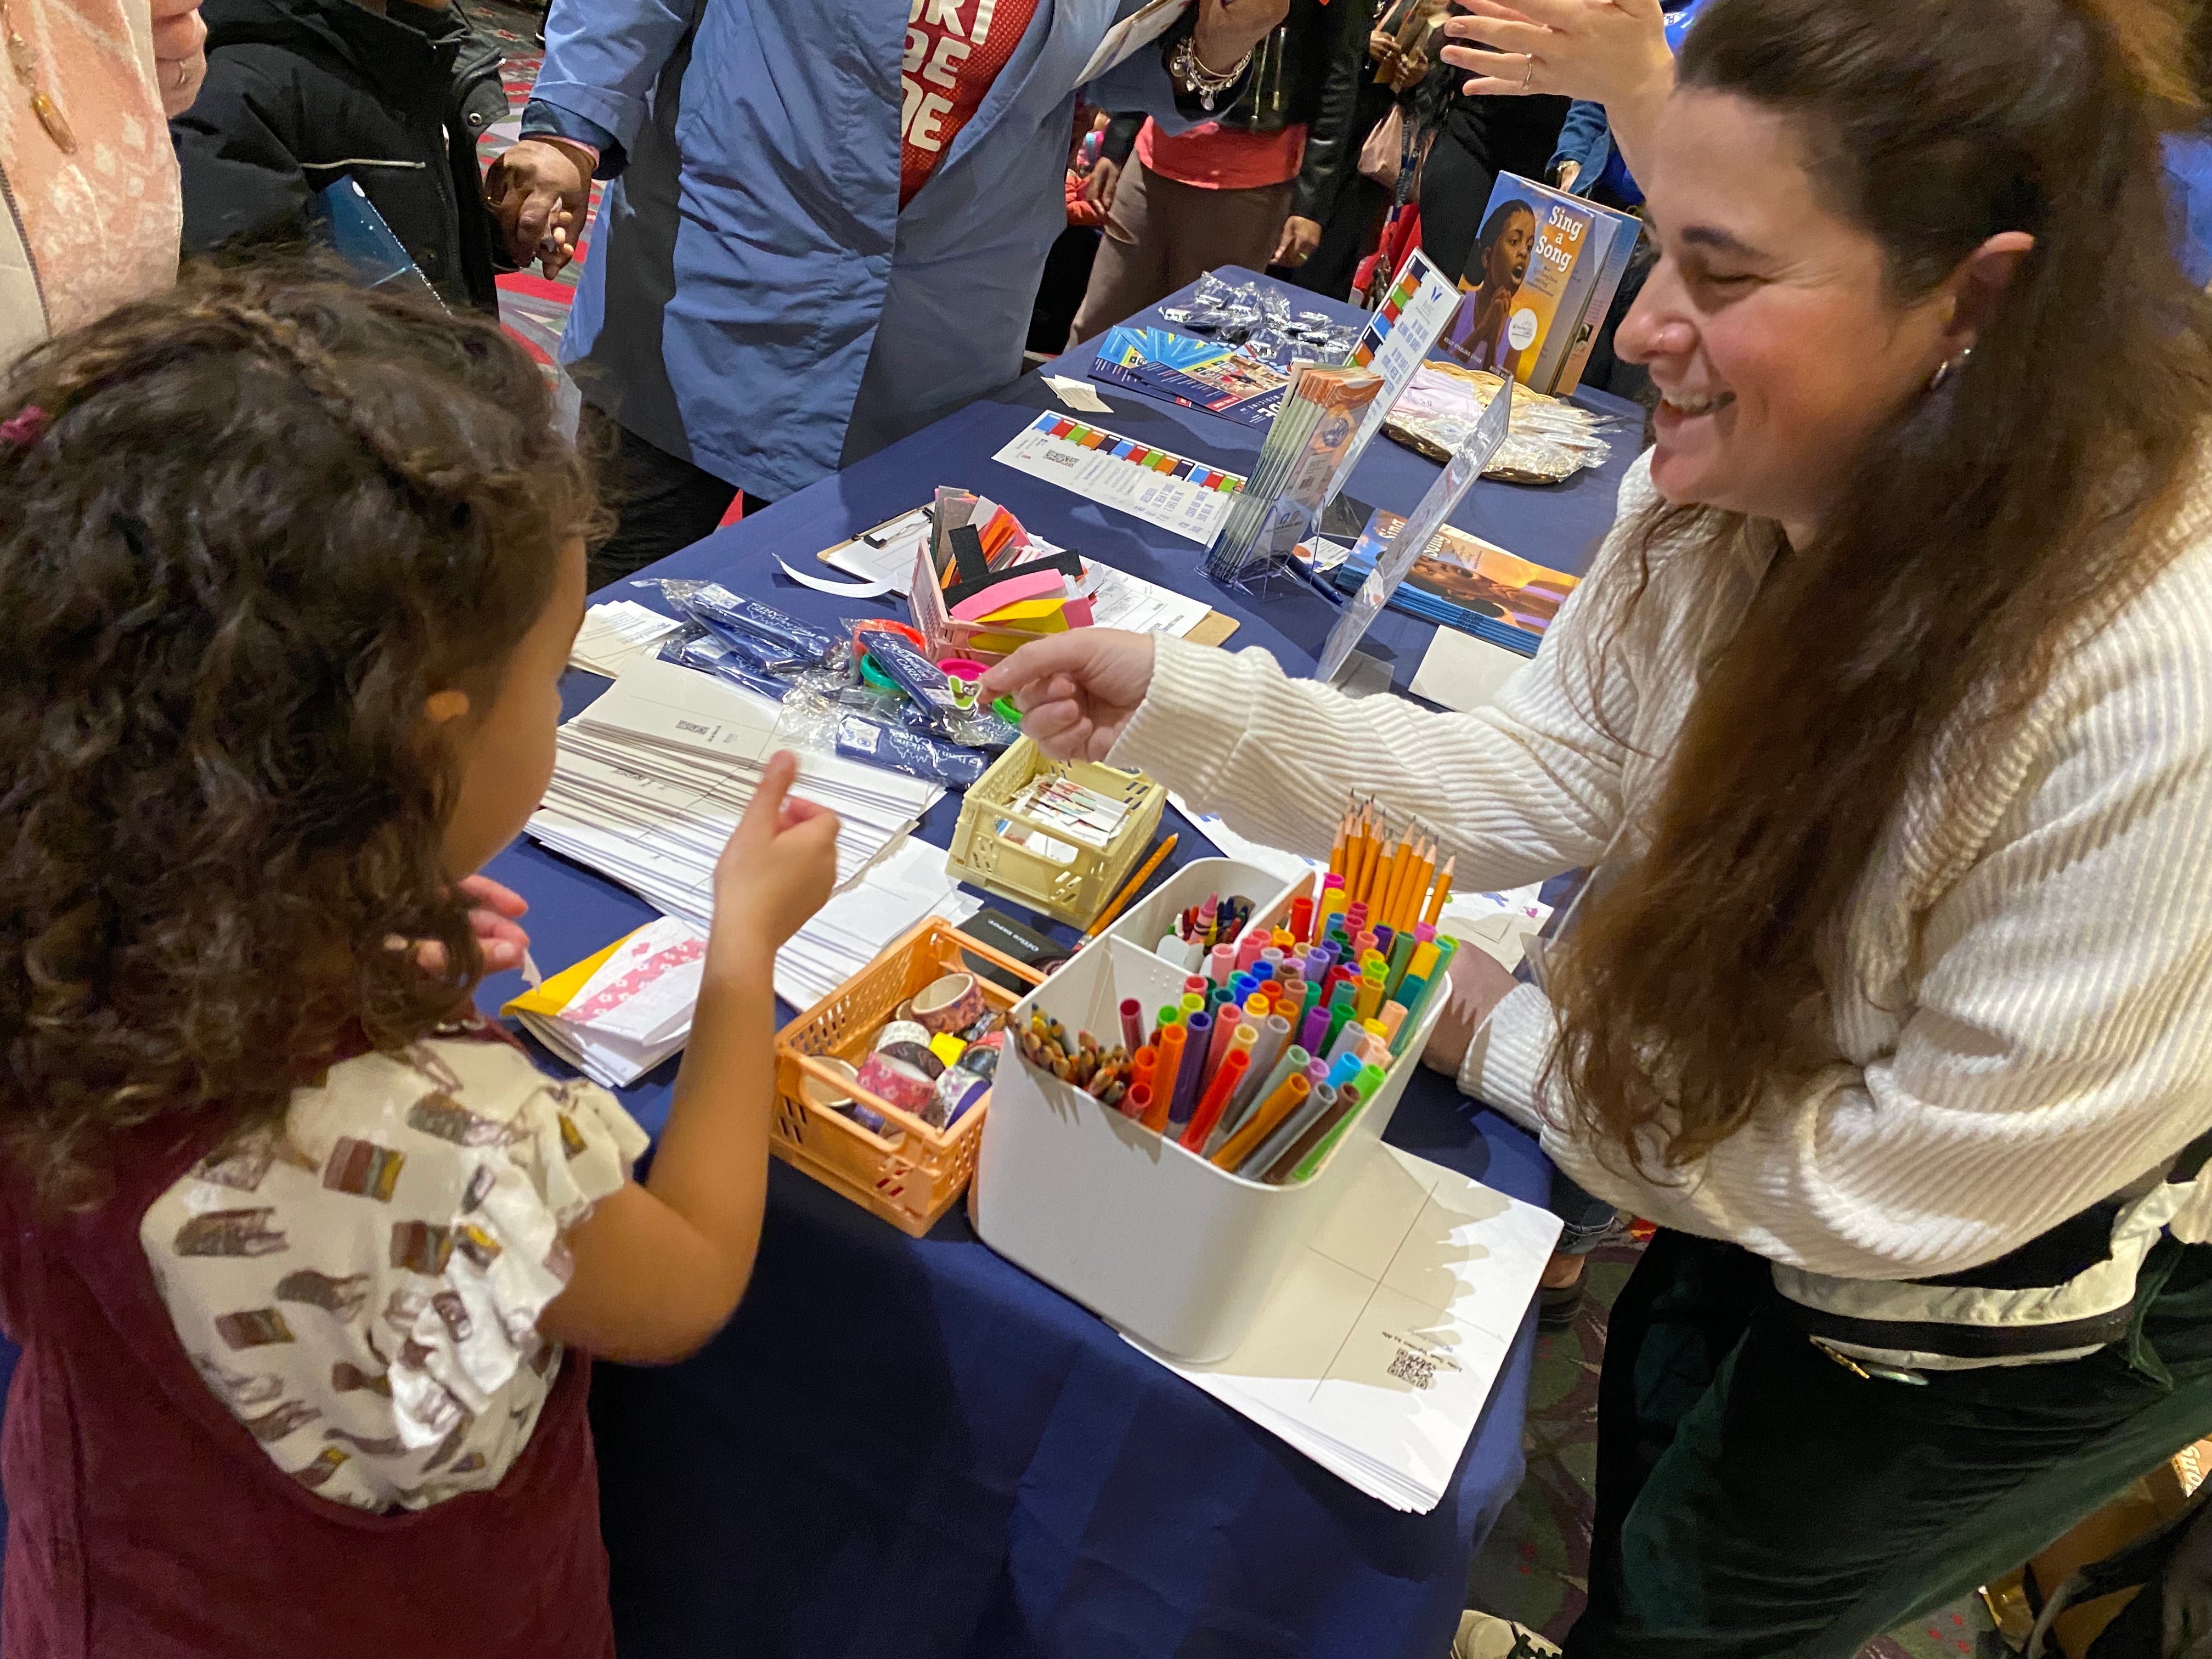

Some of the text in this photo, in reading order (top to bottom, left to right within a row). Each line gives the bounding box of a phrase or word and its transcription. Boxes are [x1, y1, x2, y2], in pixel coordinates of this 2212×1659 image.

[1548, 205, 1583, 241] Sing
[1536, 235, 1572, 272] Song
[1555, 233, 1563, 245] a
[896, 658, 923, 682] CARES
